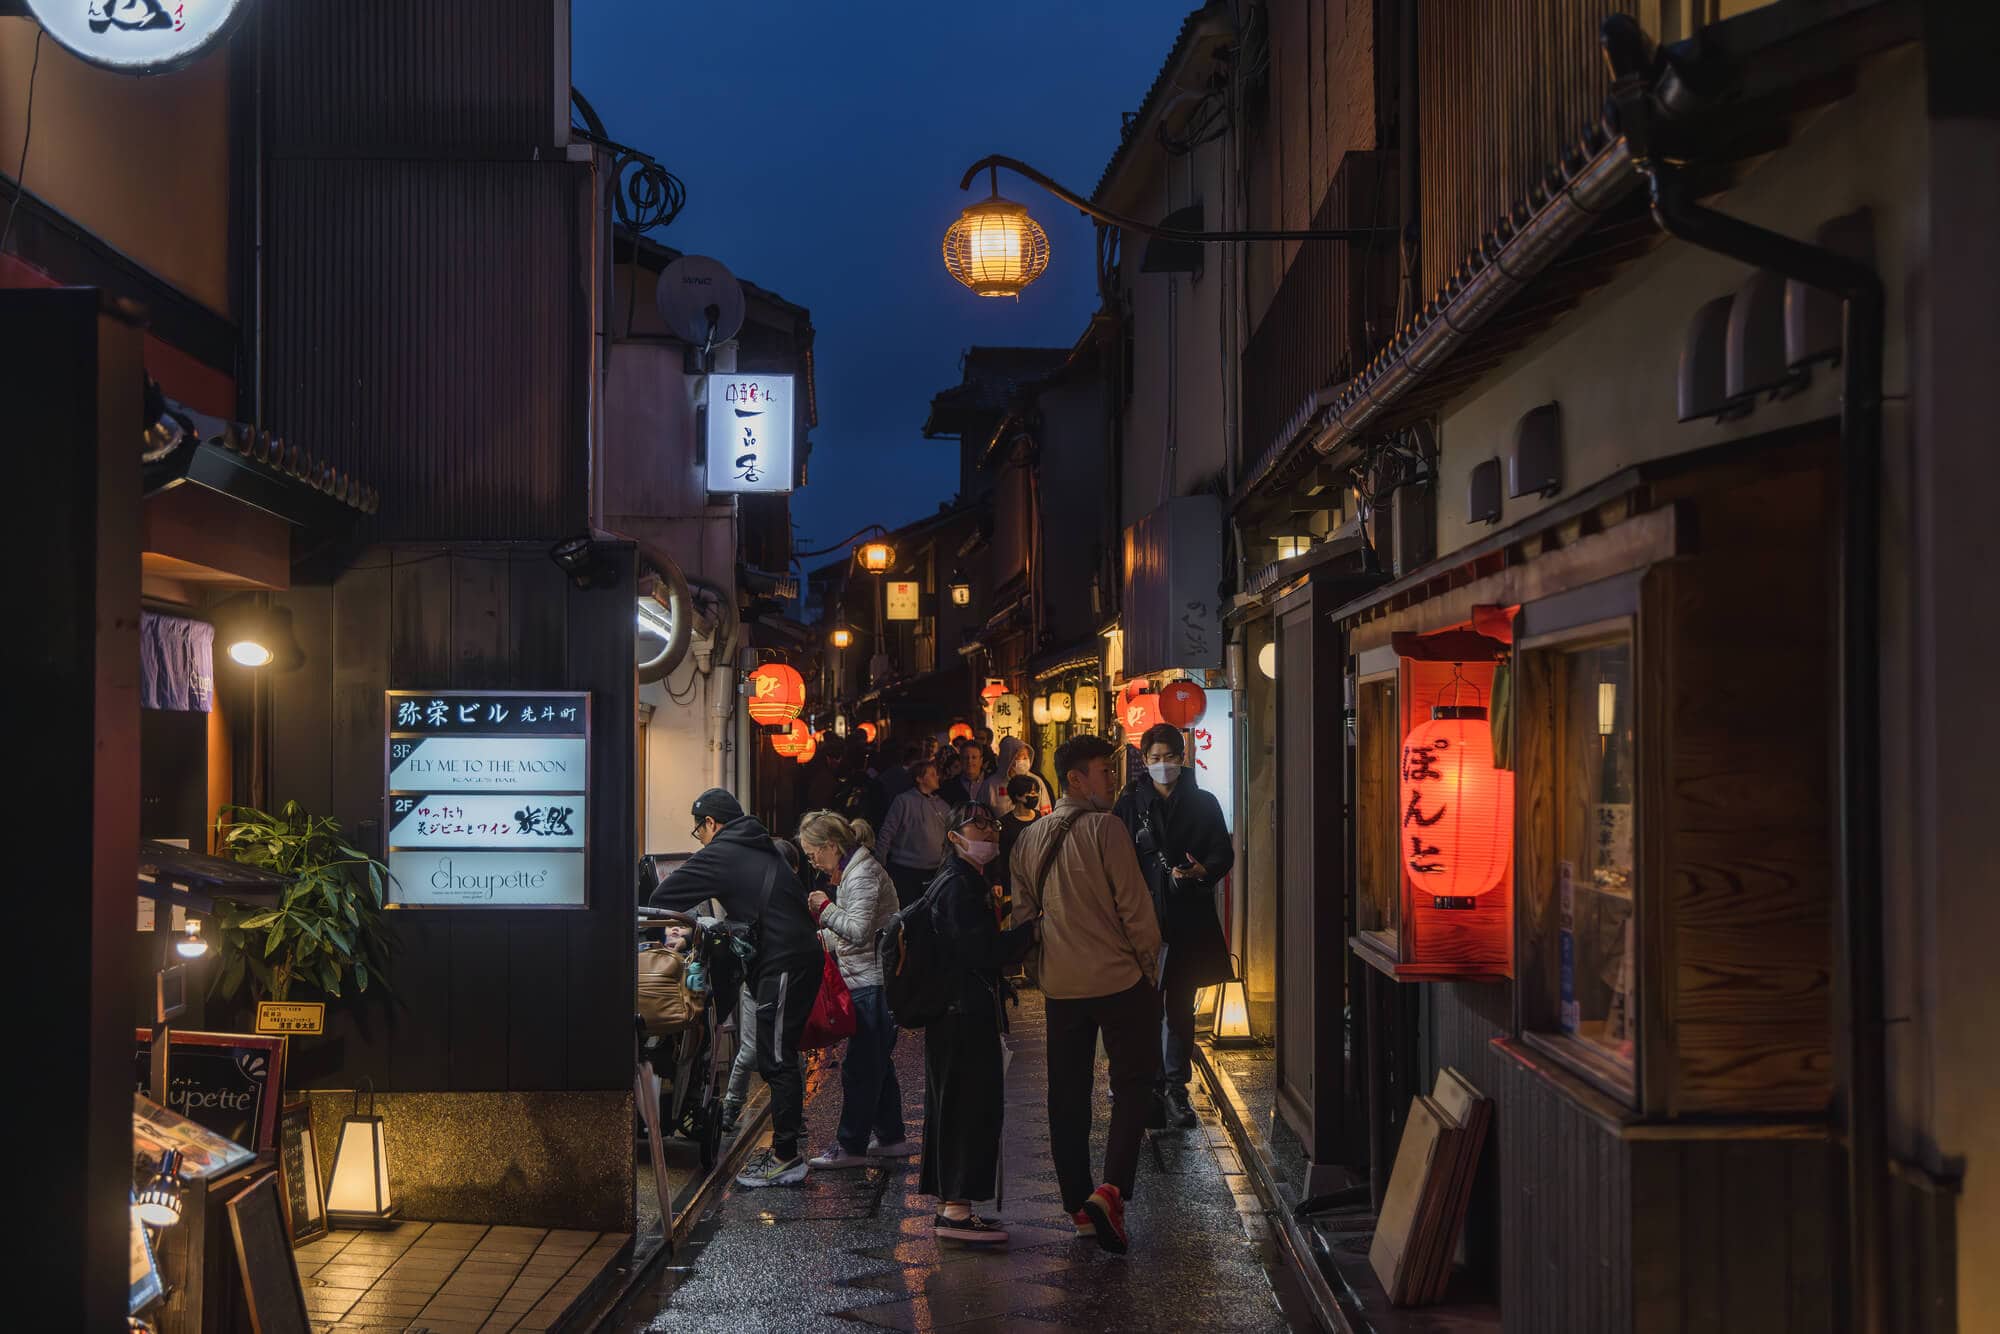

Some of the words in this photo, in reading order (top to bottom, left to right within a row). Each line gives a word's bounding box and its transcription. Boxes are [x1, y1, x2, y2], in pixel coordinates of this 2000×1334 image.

[174, 0, 186, 32] イン
[398, 701, 509, 726] 弥栄ビル
[521, 706, 577, 722] 先斗町
[393, 744, 411, 758] 3F
[410, 760, 433, 773] FLY
[438, 760, 459, 773] ME
[463, 760, 483, 773] TO
[488, 760, 513, 773] THE
[519, 760, 567, 773] MOON
[395, 800, 413, 812] 2F
[418, 806, 463, 819] ゆったり
